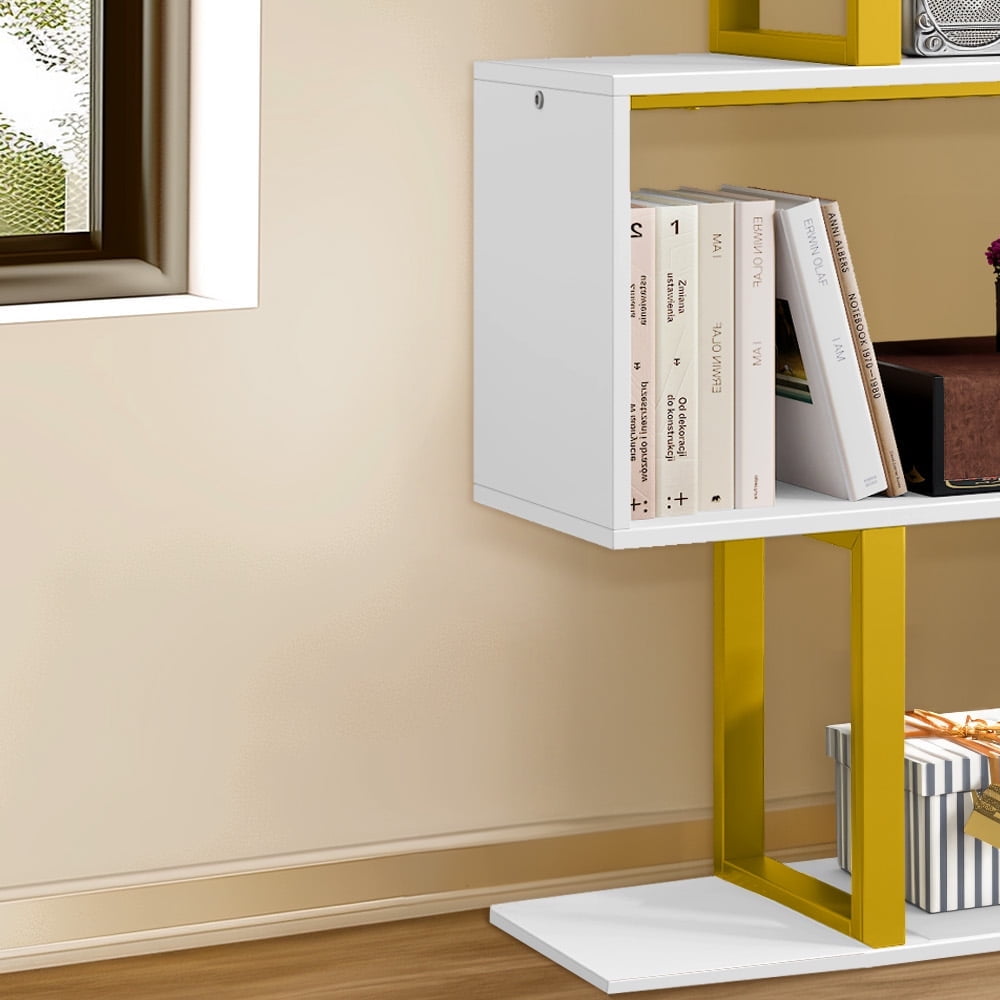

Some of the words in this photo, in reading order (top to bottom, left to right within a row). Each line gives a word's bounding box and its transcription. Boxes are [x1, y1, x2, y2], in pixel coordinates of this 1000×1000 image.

[671, 220, 679, 235] 1
[667, 273, 675, 322] ustawienia
[678, 280, 686, 314] Zmiana
[804, 218, 818, 256] ERWIN
[813, 258, 828, 286] OLAF
[833, 344, 846, 362] AM
[828, 213, 839, 237] ANNI
[834, 240, 849, 273] ALBERS
[848, 294, 868, 346] NOTEBOOK
[667, 395, 674, 405] do
[679, 397, 687, 411] Od
[666, 408, 675, 461] konstrukcji
[677, 414, 688, 457] dekoracji
